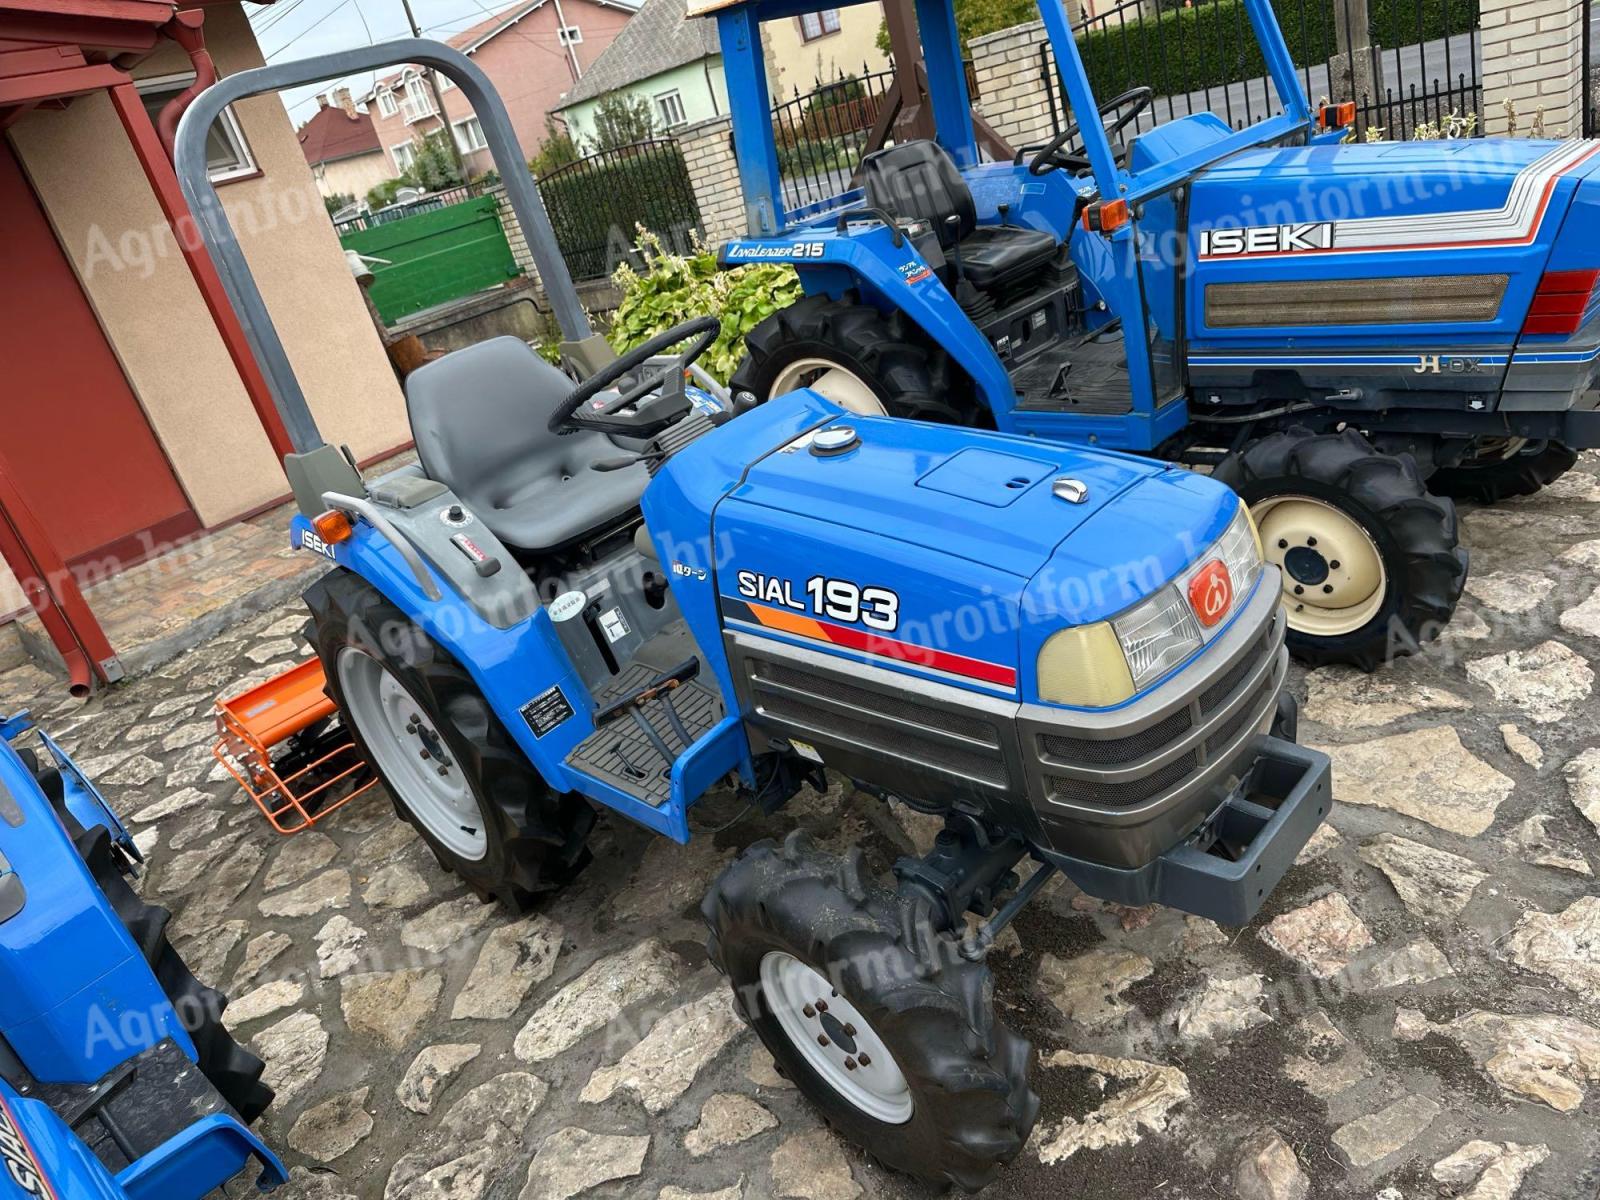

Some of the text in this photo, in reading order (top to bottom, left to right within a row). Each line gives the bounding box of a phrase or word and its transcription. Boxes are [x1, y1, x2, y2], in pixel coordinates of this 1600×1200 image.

[791, 242, 825, 257] 215
[1200, 221, 1336, 255] ISEKI
[302, 529, 336, 559] ISEKI
[737, 570, 899, 632] SIAL 193
